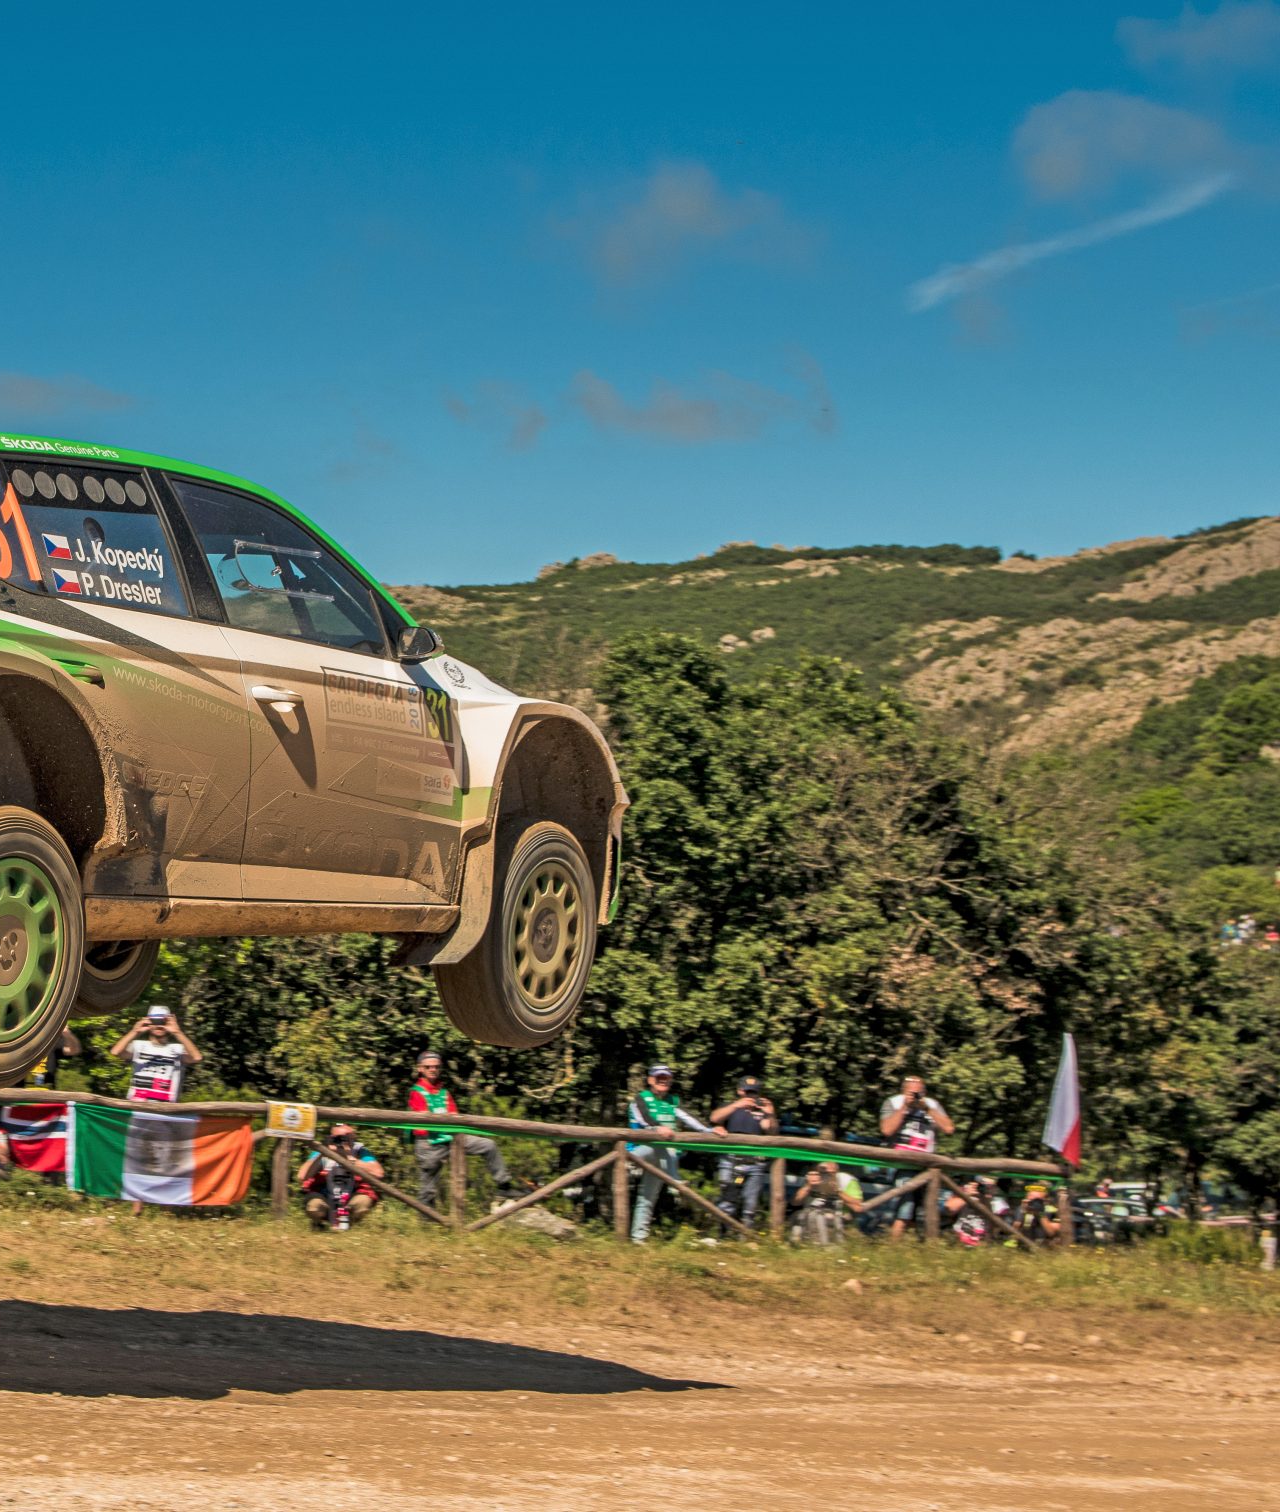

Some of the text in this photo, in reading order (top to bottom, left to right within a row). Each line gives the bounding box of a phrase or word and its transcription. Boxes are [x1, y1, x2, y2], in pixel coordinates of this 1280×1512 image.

[0, 436, 120, 459] ŠKODA Genuine Parts
[74, 538, 165, 578] J. Kopecký
[80, 572, 162, 606] P. Dresler
[329, 696, 407, 724] endless island
[426, 687, 450, 741] 31
[423, 775, 442, 789] sara
